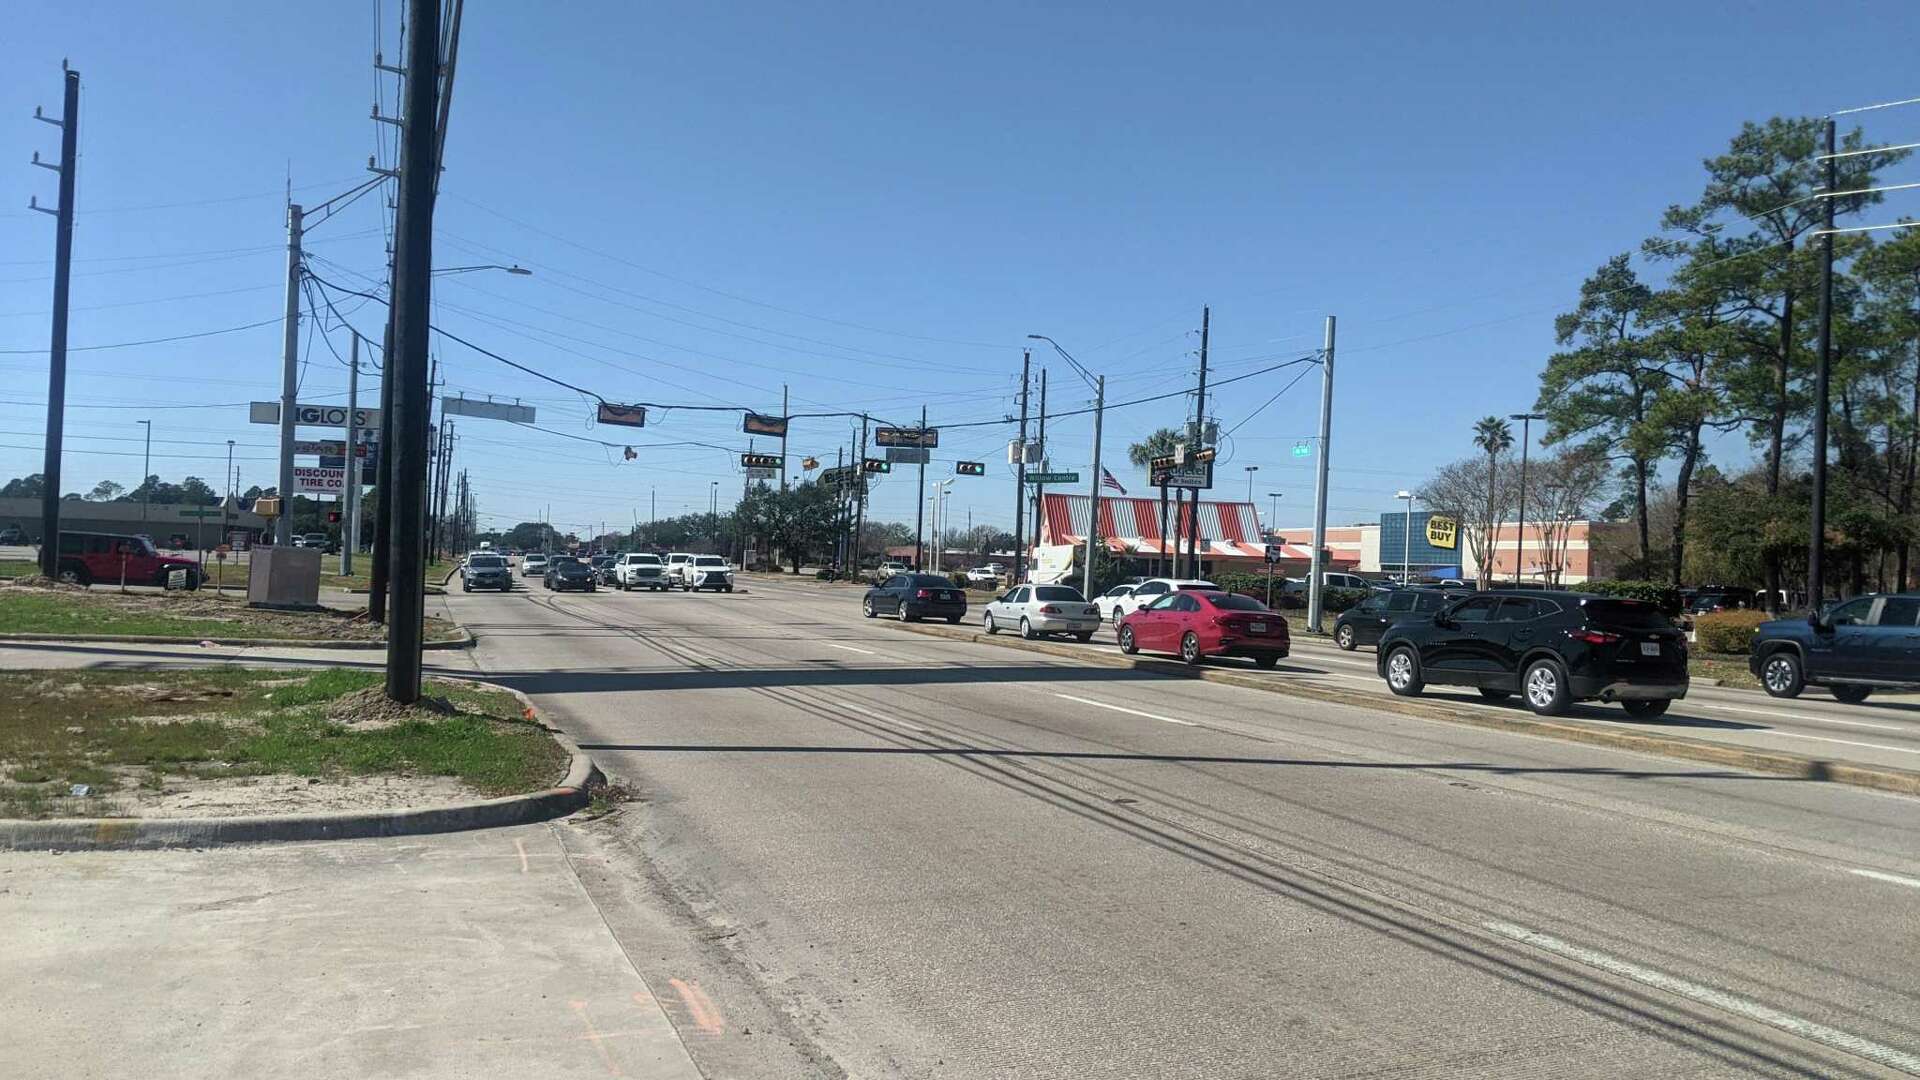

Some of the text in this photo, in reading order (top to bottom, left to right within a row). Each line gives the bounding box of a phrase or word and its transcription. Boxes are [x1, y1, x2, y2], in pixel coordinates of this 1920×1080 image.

[295, 468, 344, 479] DISCOUN
[300, 478, 324, 487] TIRE
[1431, 520, 1454, 532] BEST
[1431, 531, 1451, 541] BUY
